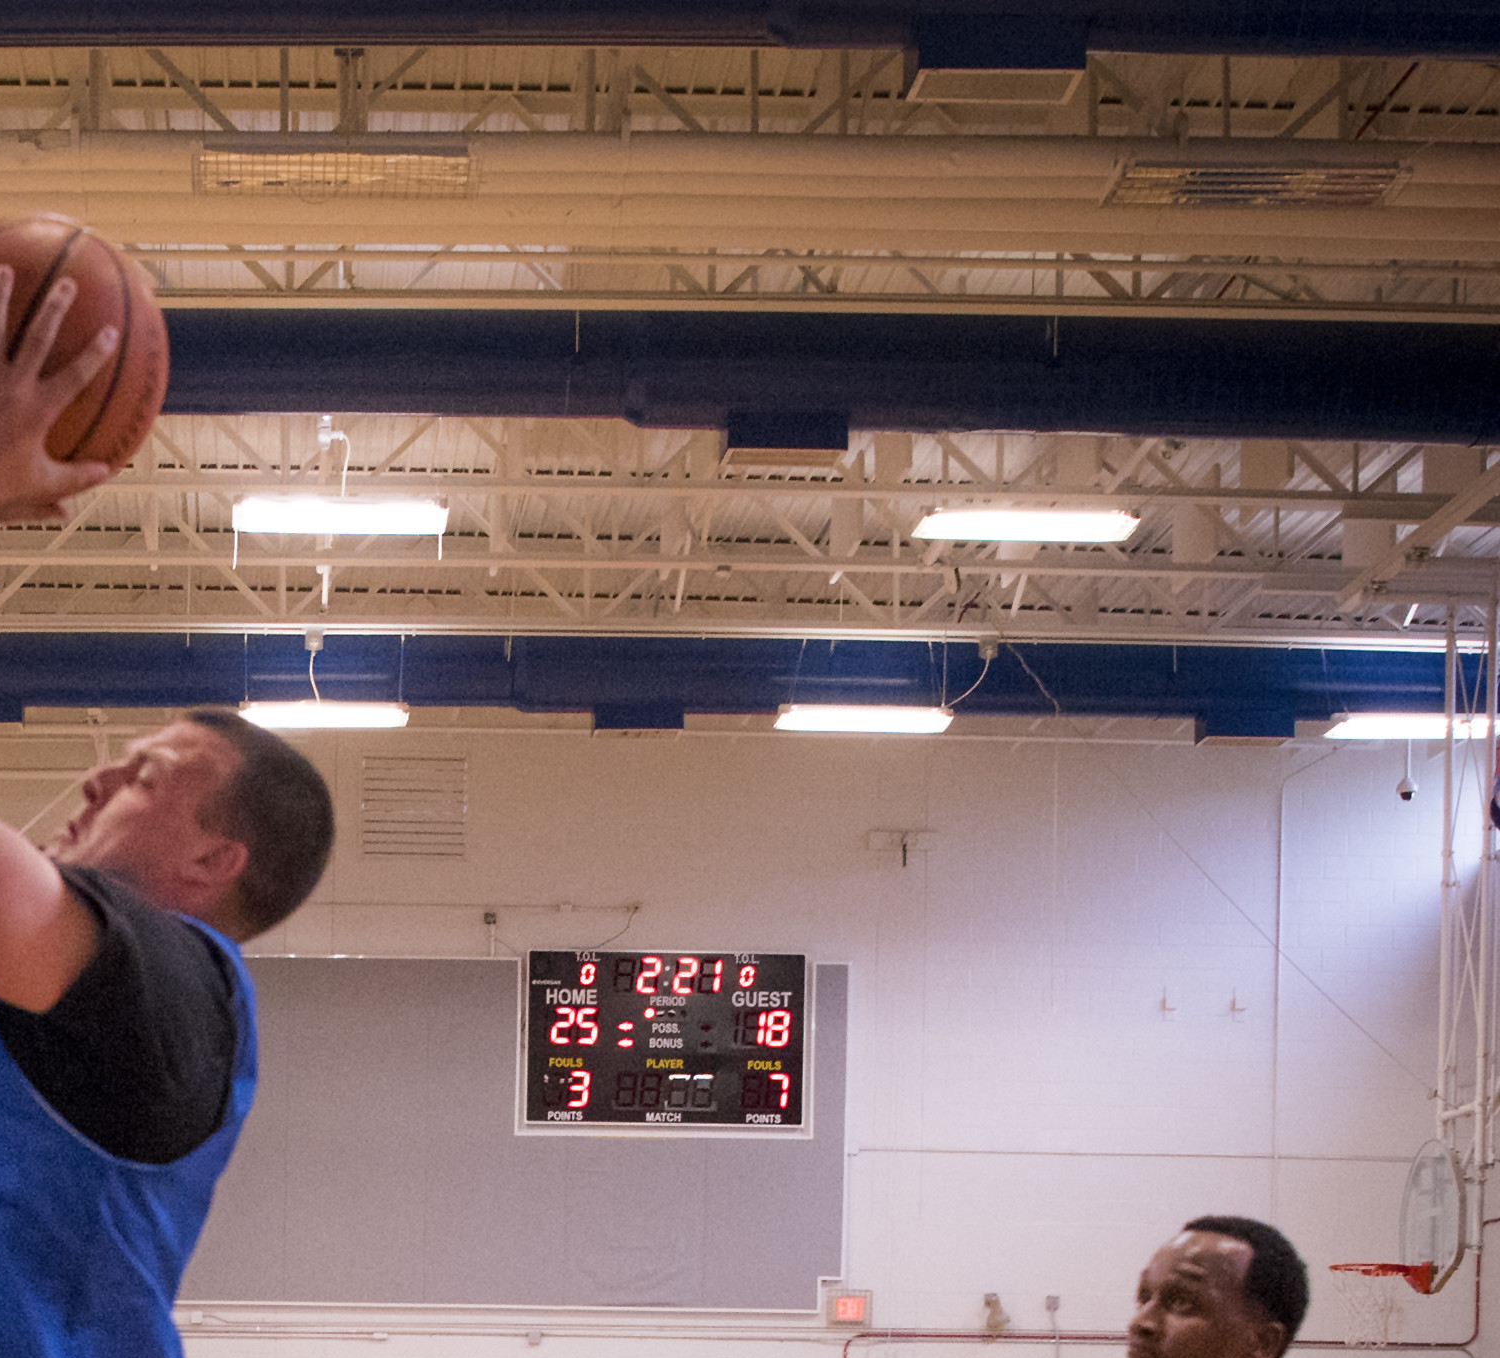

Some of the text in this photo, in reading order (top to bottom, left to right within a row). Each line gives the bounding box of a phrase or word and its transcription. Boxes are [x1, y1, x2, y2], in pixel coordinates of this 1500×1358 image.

[580, 962, 597, 986] 0
[636, 956, 723, 995] 2:21
[739, 965, 756, 988] 0
[545, 988, 598, 1005] HOME
[649, 996, 686, 1007] PERIOD
[731, 990, 793, 1008] GUEST
[550, 1007, 599, 1045] 25
[651, 1022, 680, 1034] POSS.
[756, 1010, 792, 1048] 18
[649, 1037, 684, 1049] BONUS
[548, 1057, 584, 1068] FOULS
[646, 1058, 684, 1069] PLAYER
[747, 1060, 782, 1071] FOULS
[567, 1069, 592, 1108] 3
[768, 1073, 790, 1109] 7
[547, 1110, 583, 1121] POINTS
[645, 1112, 682, 1123] MATCH
[746, 1113, 782, 1124] POINTS
